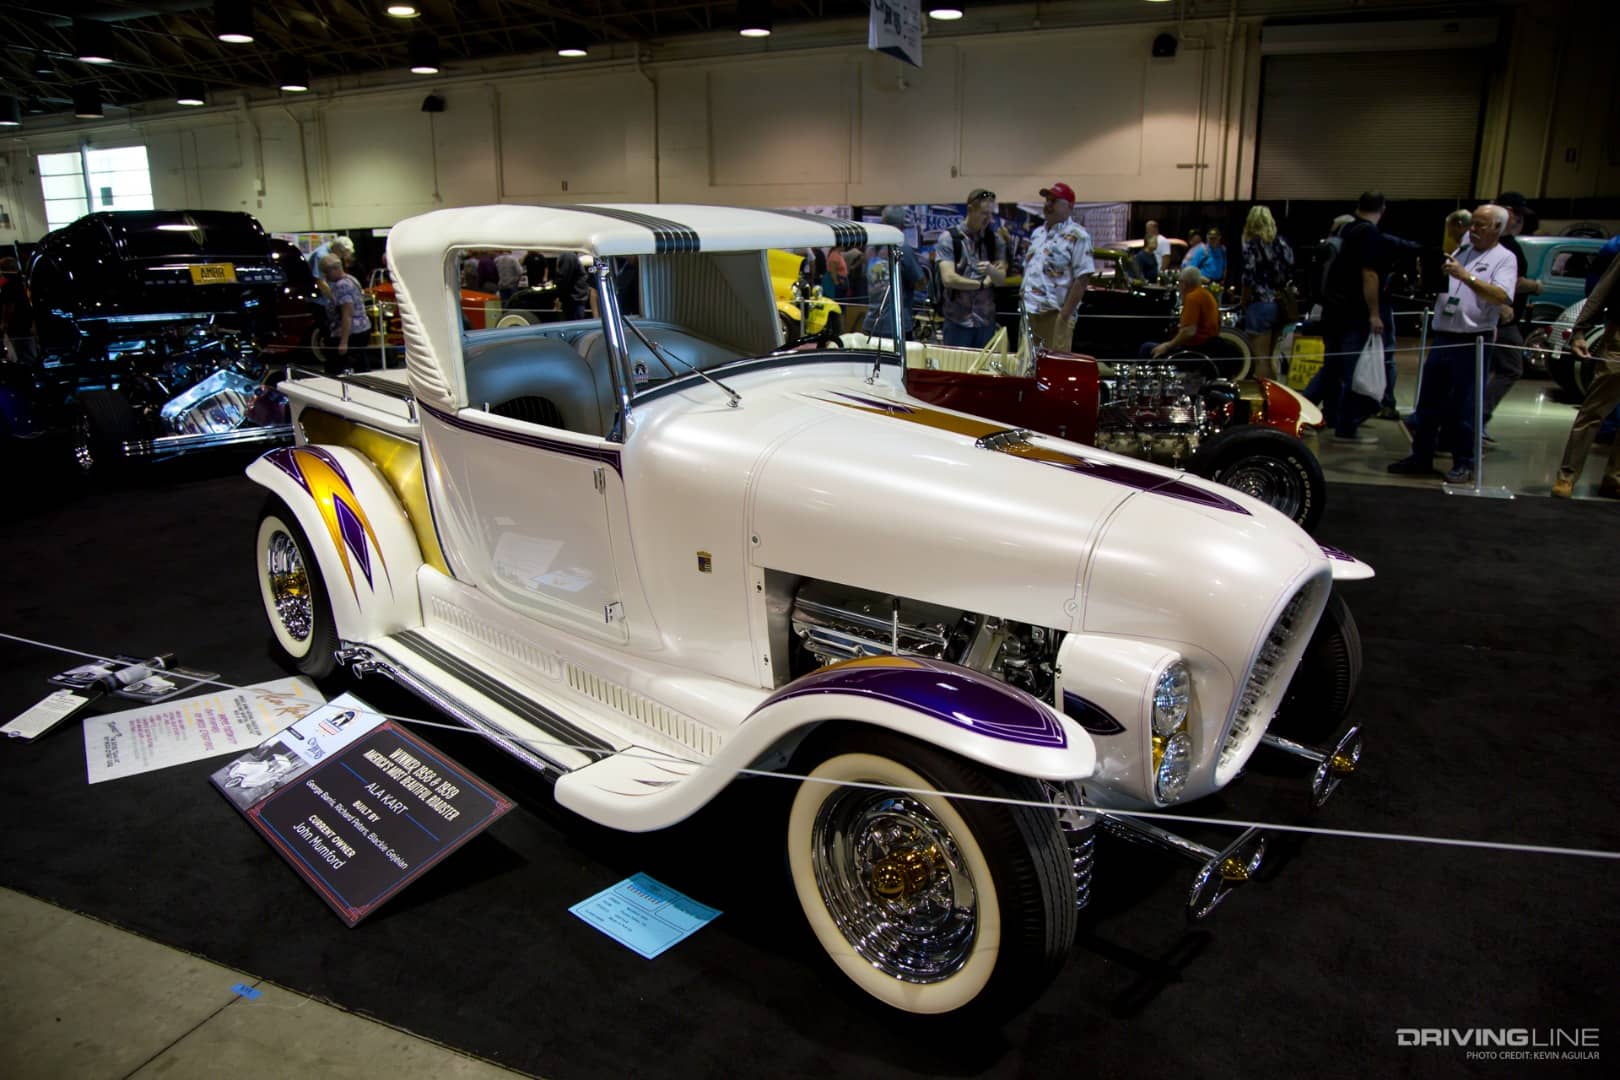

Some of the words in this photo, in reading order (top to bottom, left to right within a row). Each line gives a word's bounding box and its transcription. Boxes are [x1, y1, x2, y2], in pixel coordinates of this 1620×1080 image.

[363, 749, 394, 771] AMERICA'S
[386, 766, 408, 781] MOST
[400, 776, 432, 801] BEAUTIFUL
[426, 795, 460, 821] ROADSTER
[389, 748, 421, 774] WINNER
[412, 765, 437, 782] 1958
[435, 781, 459, 799] 1959
[306, 780, 323, 795] George
[334, 803, 355, 821] Richard
[351, 818, 369, 836] Peters,
[367, 833, 388, 852] Blackie
[352, 800, 372, 815] BUILT
[368, 813, 380, 822] BY
[365, 783, 385, 798] ALA
[380, 794, 408, 814] KART
[293, 823, 313, 840] John
[309, 836, 346, 869] Mumford
[309, 815, 336, 838] CURRENT
[332, 836, 355, 858] OWNER
